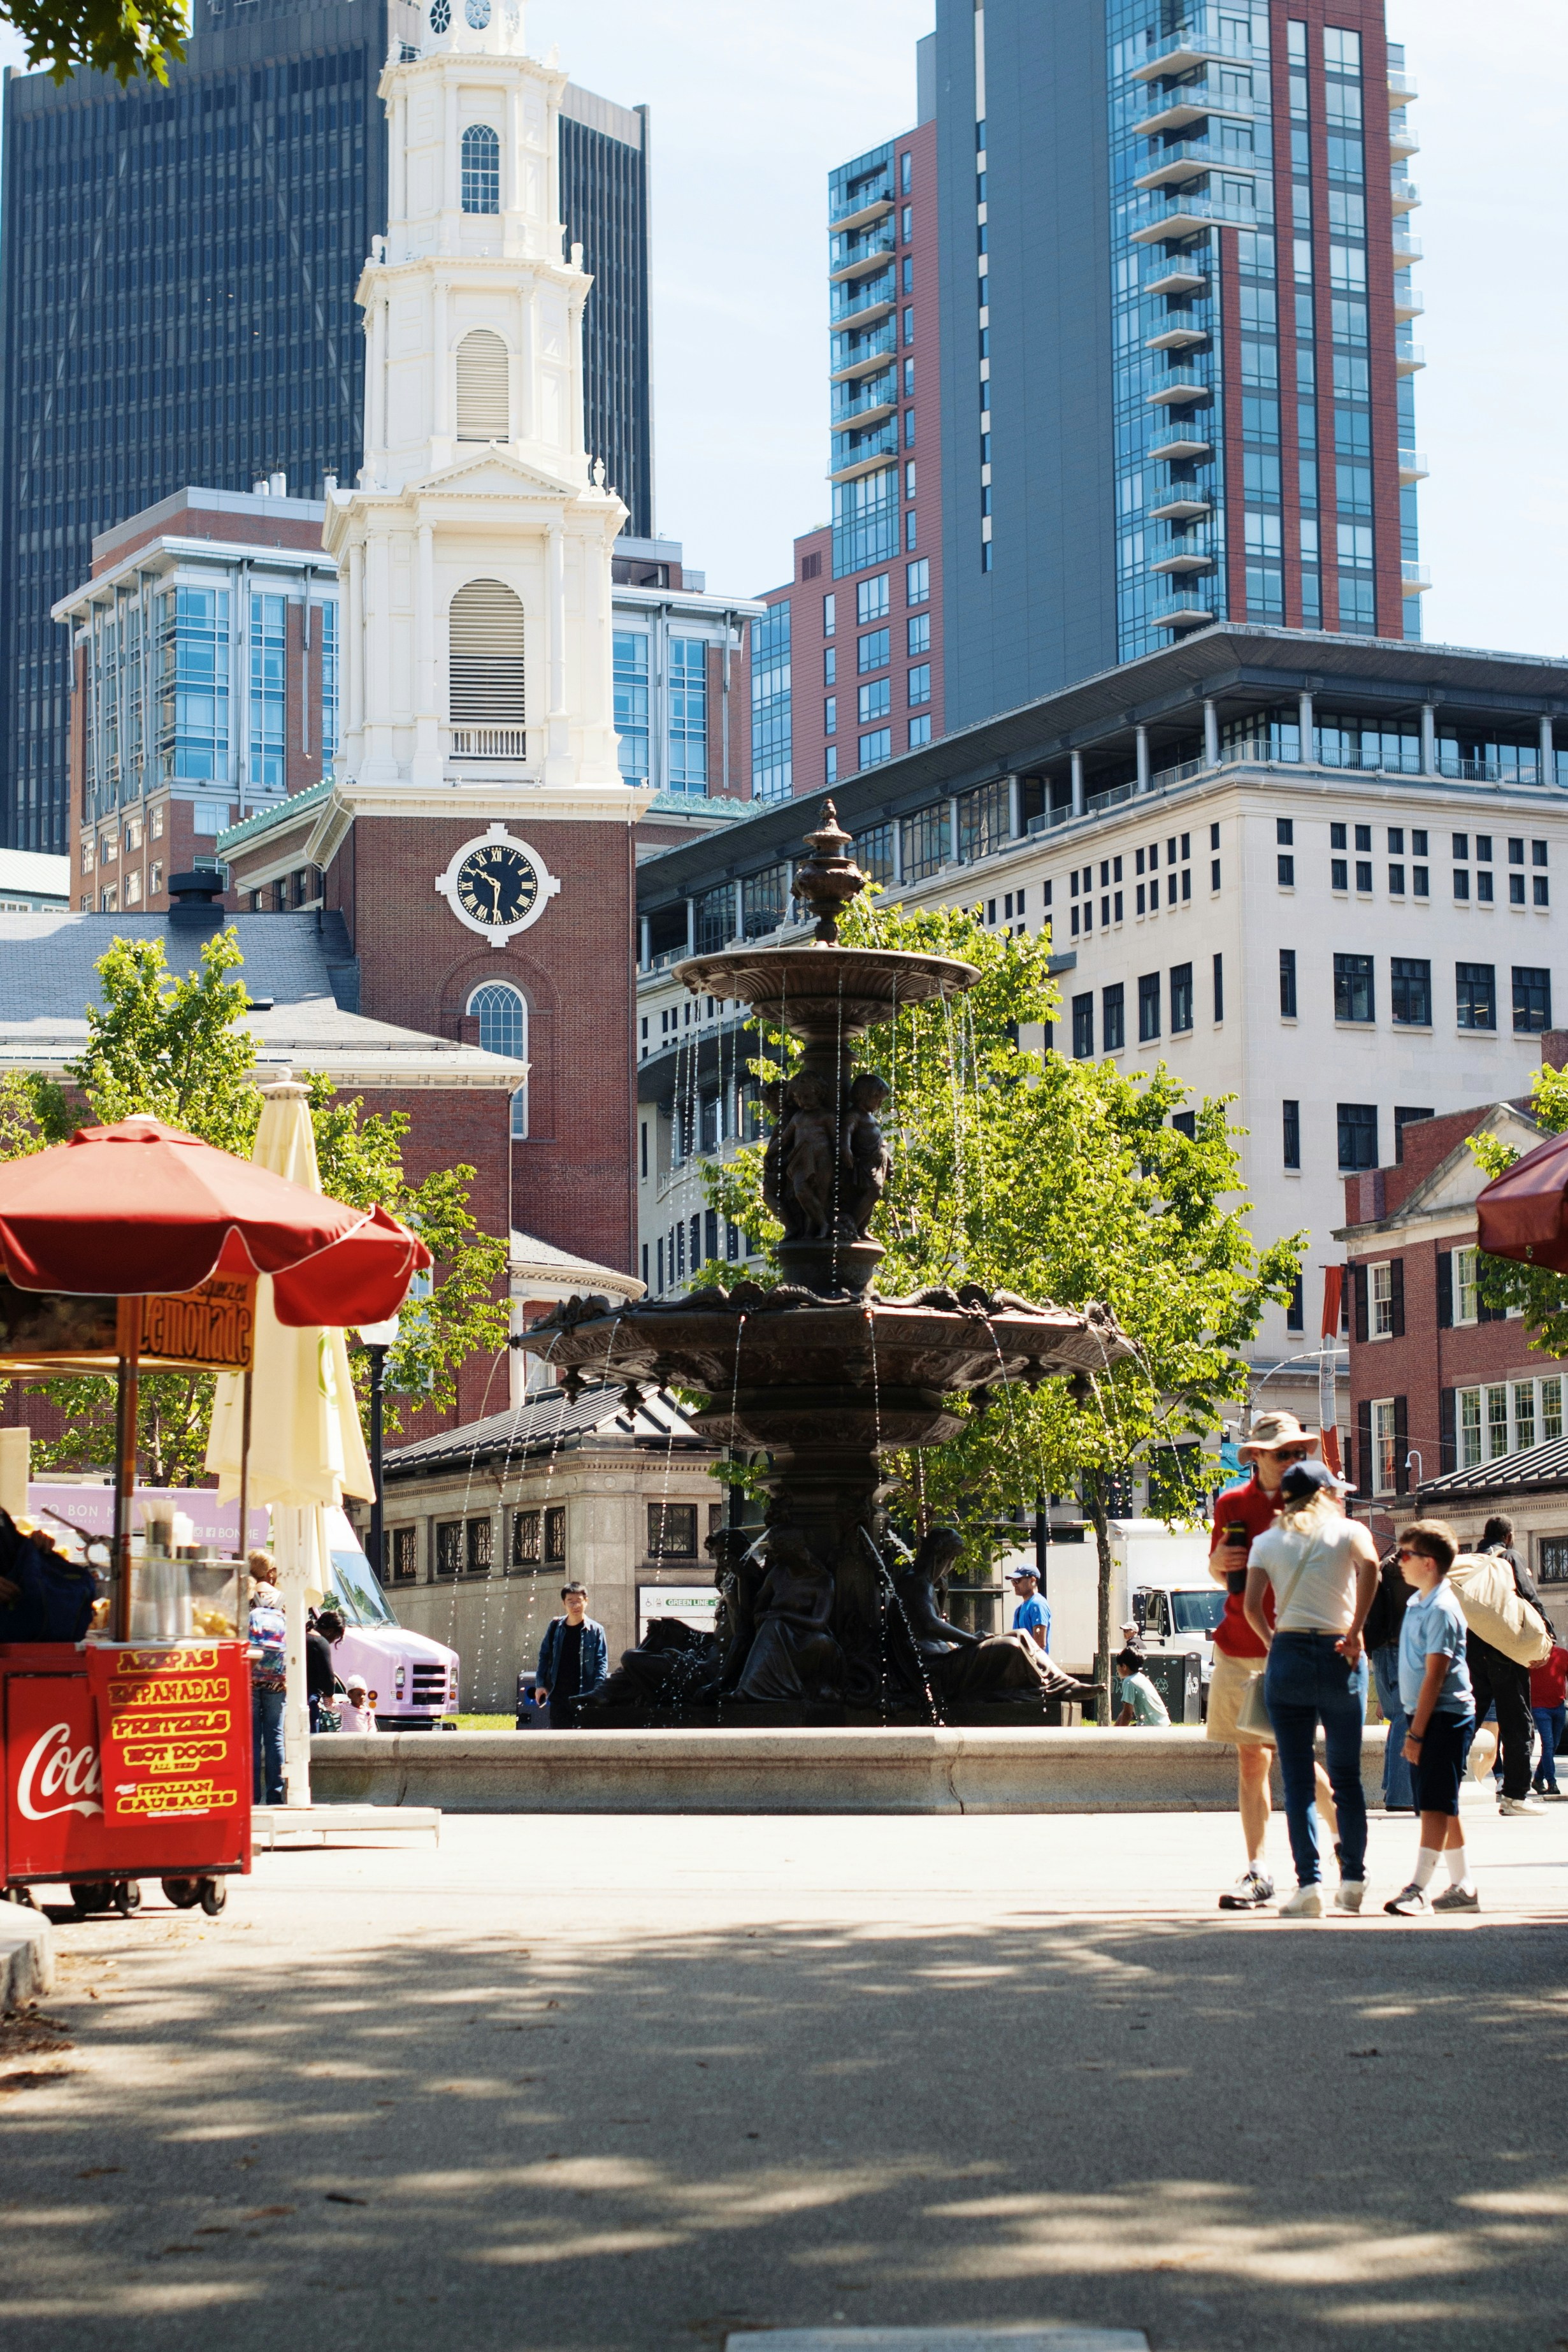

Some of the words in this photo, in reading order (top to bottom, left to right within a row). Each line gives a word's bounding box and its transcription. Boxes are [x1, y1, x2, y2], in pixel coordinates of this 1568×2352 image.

[491, 850, 502, 862] XII
[68, 1504, 98, 1518] BON
[118, 1650, 217, 1672] AREPAS
[108, 1678, 229, 1705] EMPANADAS
[113, 1711, 229, 1738] PRETZELS
[125, 1745, 169, 1764] HOT
[171, 1741, 226, 1762] DOGS
[139, 1782, 212, 1796] ITALIAN
[118, 1791, 235, 1812] SAUSAGES
